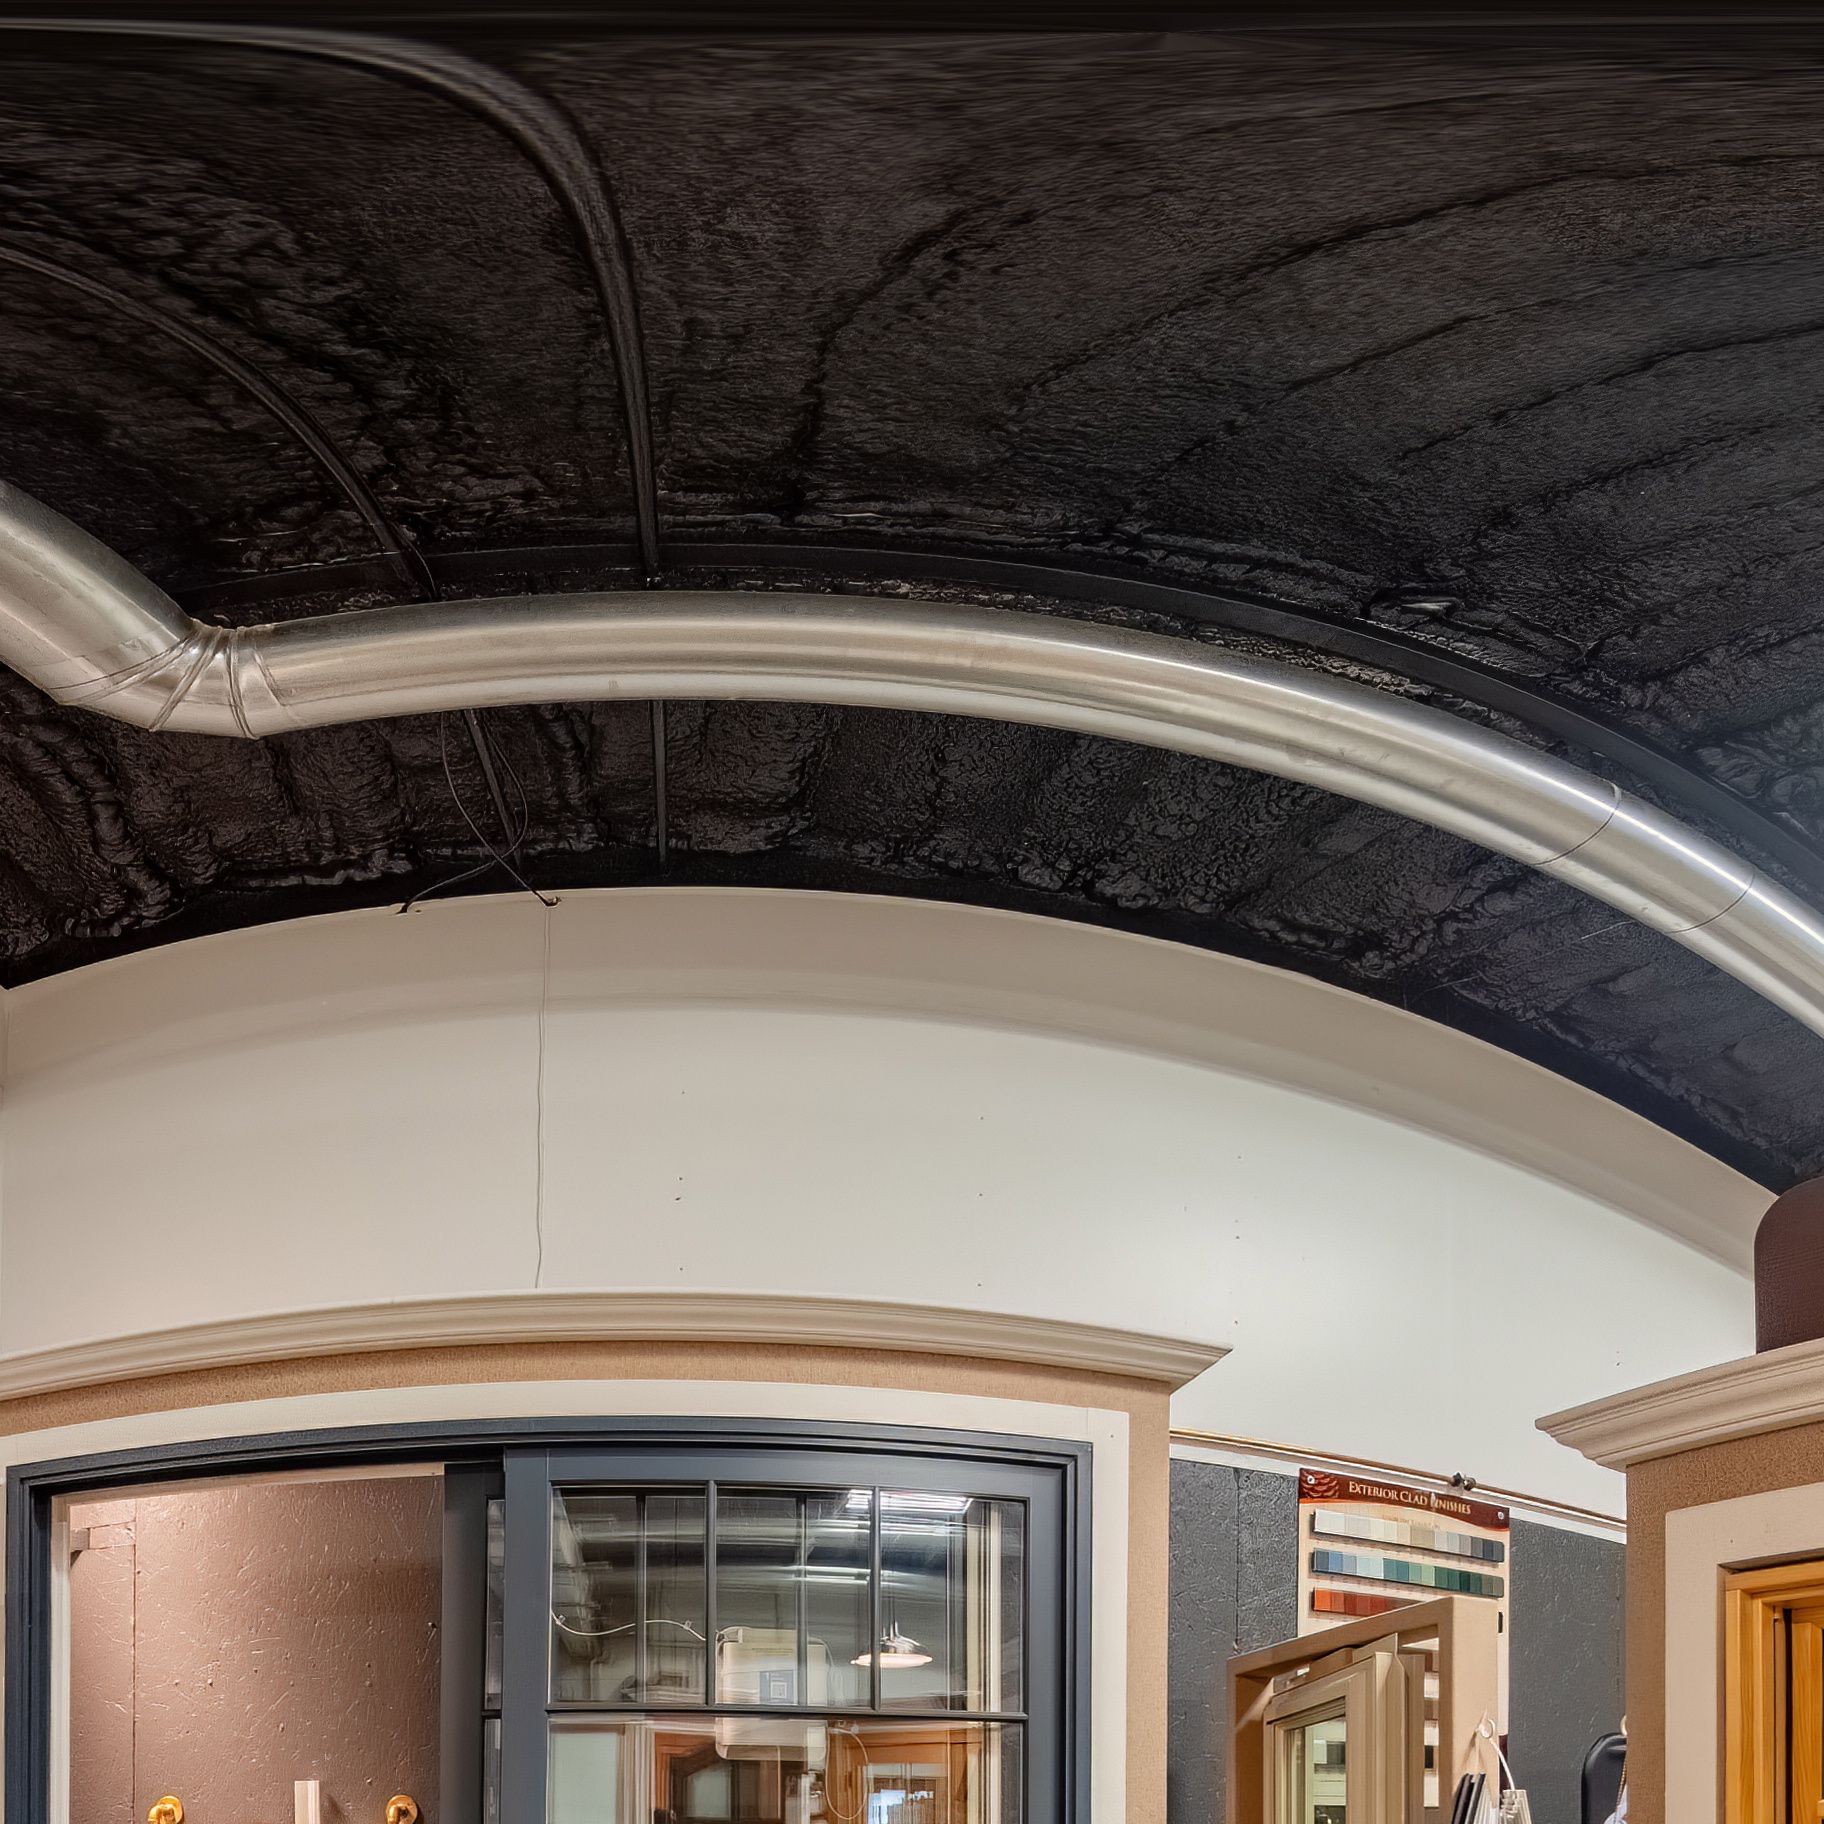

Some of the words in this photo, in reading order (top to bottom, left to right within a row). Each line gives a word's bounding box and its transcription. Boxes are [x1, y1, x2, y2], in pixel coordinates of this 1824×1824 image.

[1349, 1481, 1399, 1501] EXTERIOR
[1400, 1490, 1428, 1506] CLAD
[1431, 1494, 1471, 1515] INISHES
